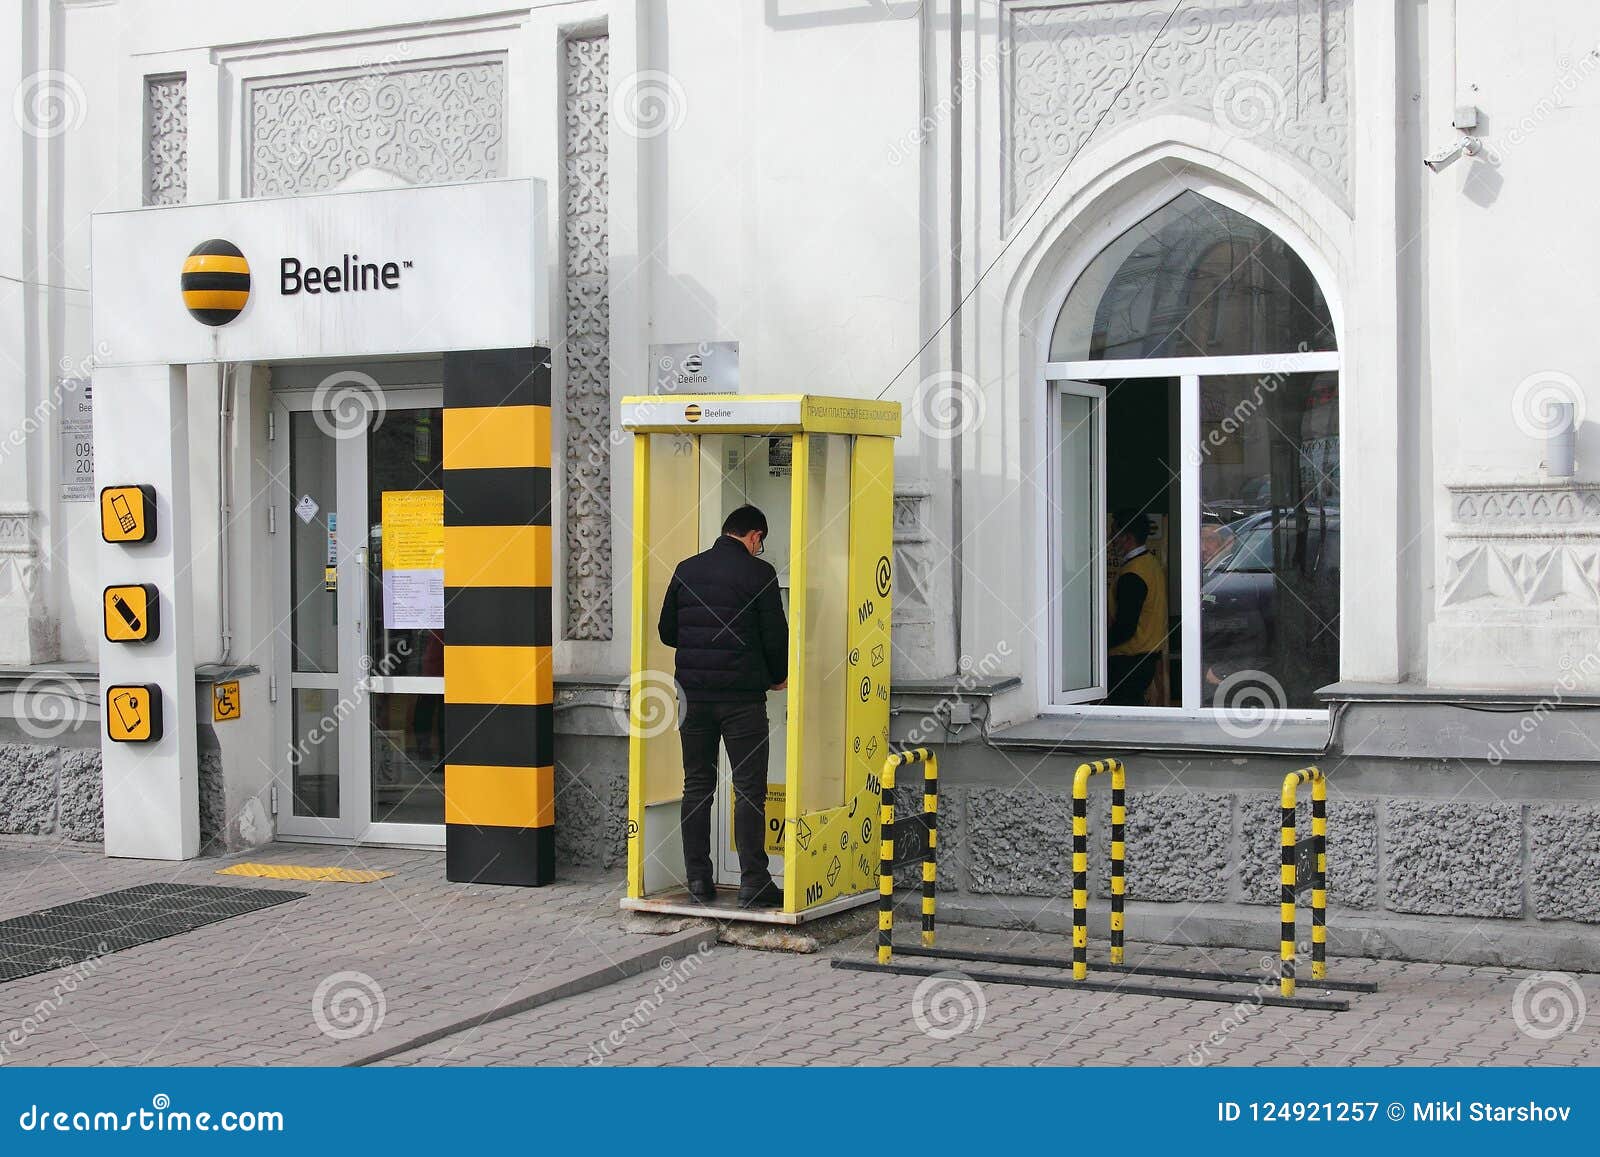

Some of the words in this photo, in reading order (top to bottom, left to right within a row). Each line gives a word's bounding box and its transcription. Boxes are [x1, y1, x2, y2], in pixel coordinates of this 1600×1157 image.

[678, 373, 708, 384] Beeline
[704, 408, 732, 418] Beeline
[806, 881, 823, 906] Mb
